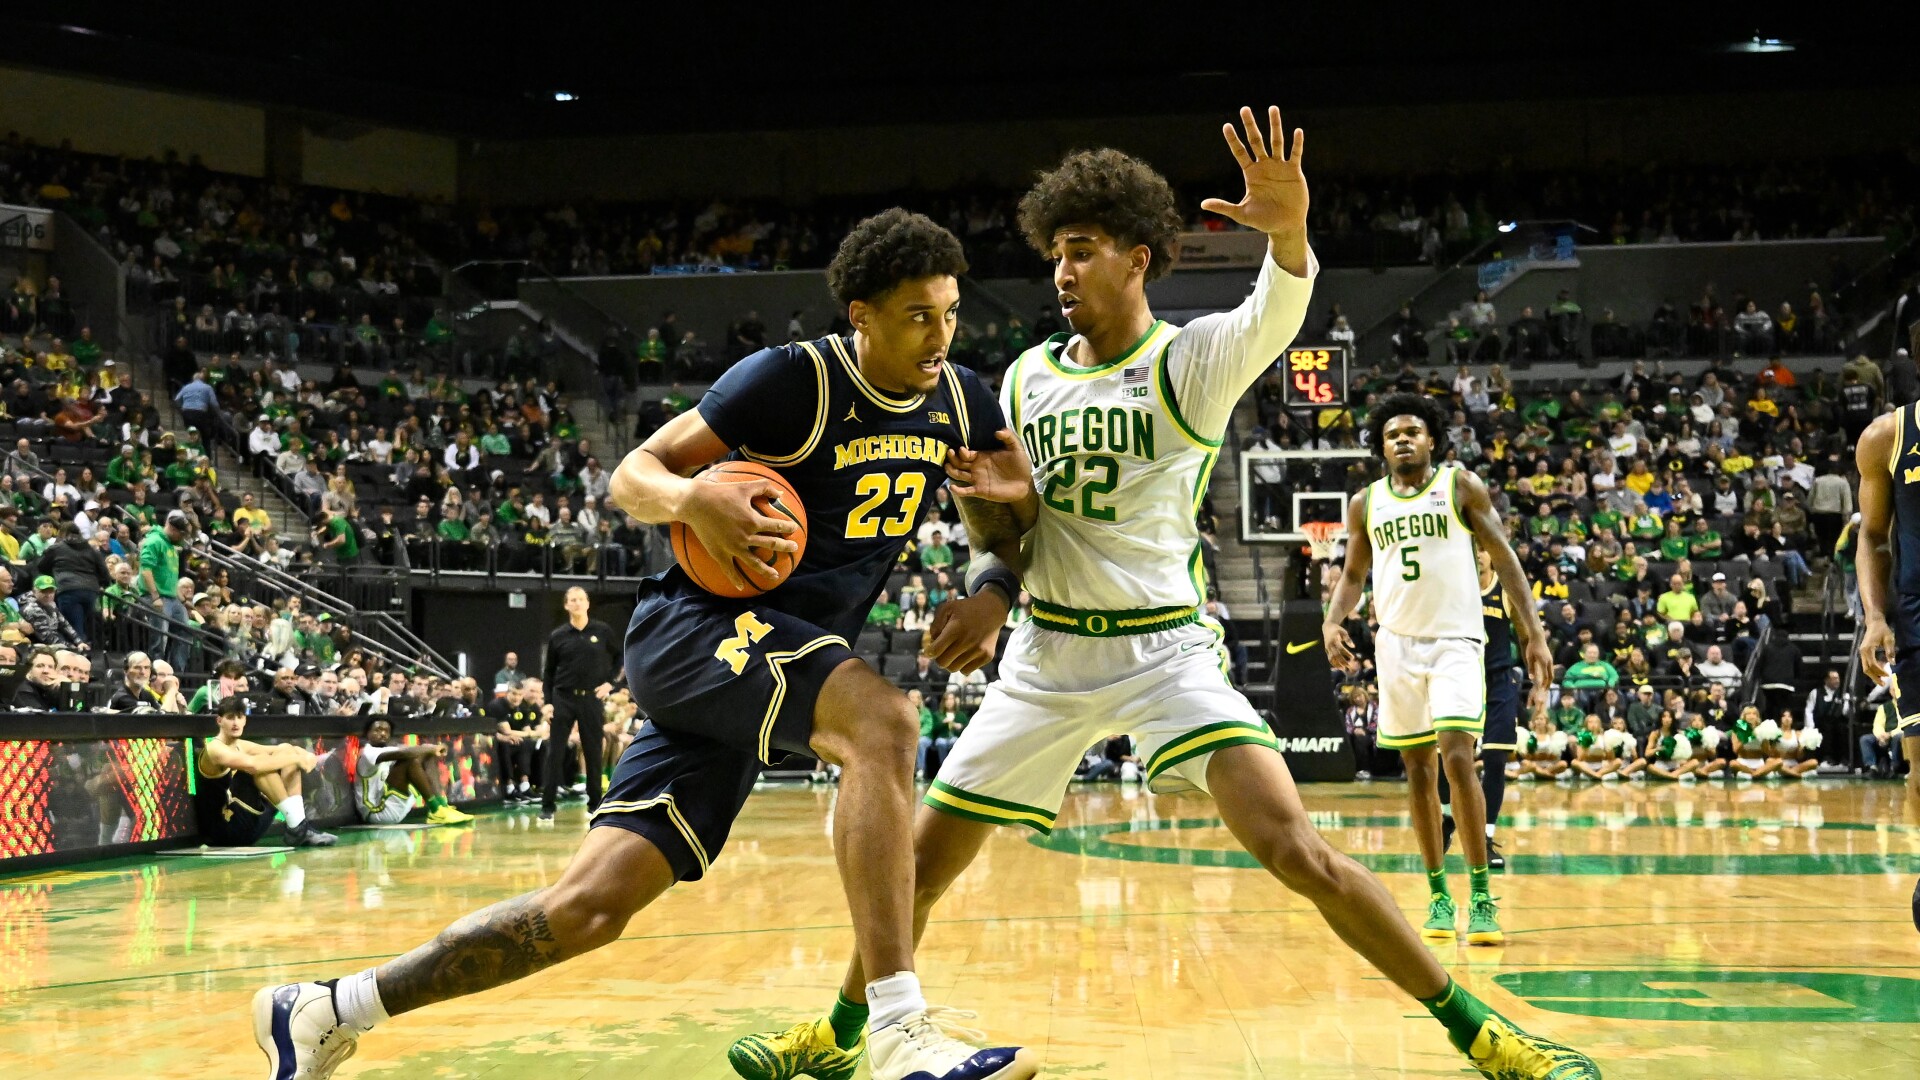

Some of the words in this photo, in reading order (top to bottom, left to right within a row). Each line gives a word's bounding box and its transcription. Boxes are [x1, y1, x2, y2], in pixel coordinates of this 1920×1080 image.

[1022, 406, 1155, 469] OREGON
[845, 472, 927, 539] 23
[1043, 455, 1120, 522] 22
[1373, 512, 1448, 551] OREGON
[1401, 545, 1421, 581] 5
[714, 610, 774, 676] M
[1086, 615, 1108, 634] O
